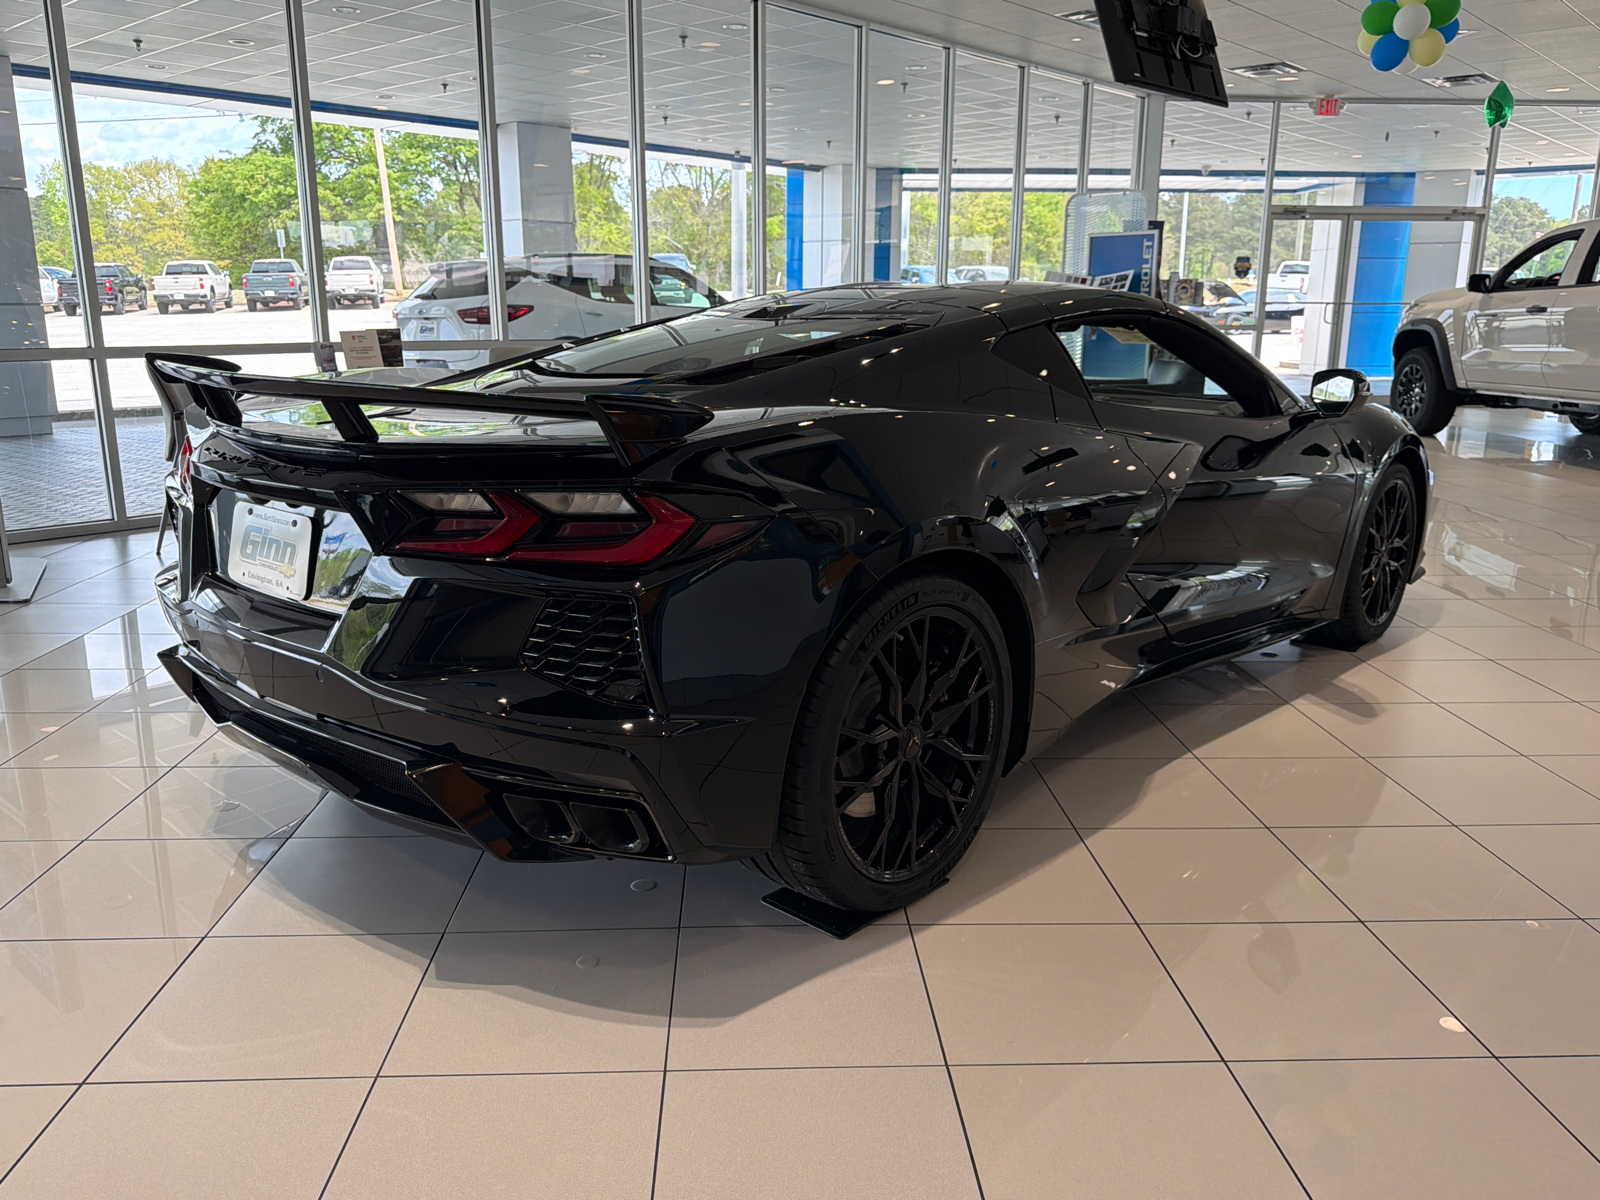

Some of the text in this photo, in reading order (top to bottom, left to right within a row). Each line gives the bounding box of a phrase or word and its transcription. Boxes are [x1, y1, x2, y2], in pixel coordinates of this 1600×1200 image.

[1319, 98, 1338, 116] EXIT
[1141, 238, 1153, 295] ROLET
[239, 523, 297, 566] Ginn
[247, 571, 283, 588] Covington, GA
[258, 562, 279, 572] CHEVROLET
[865, 595, 917, 647] MICHELIN
